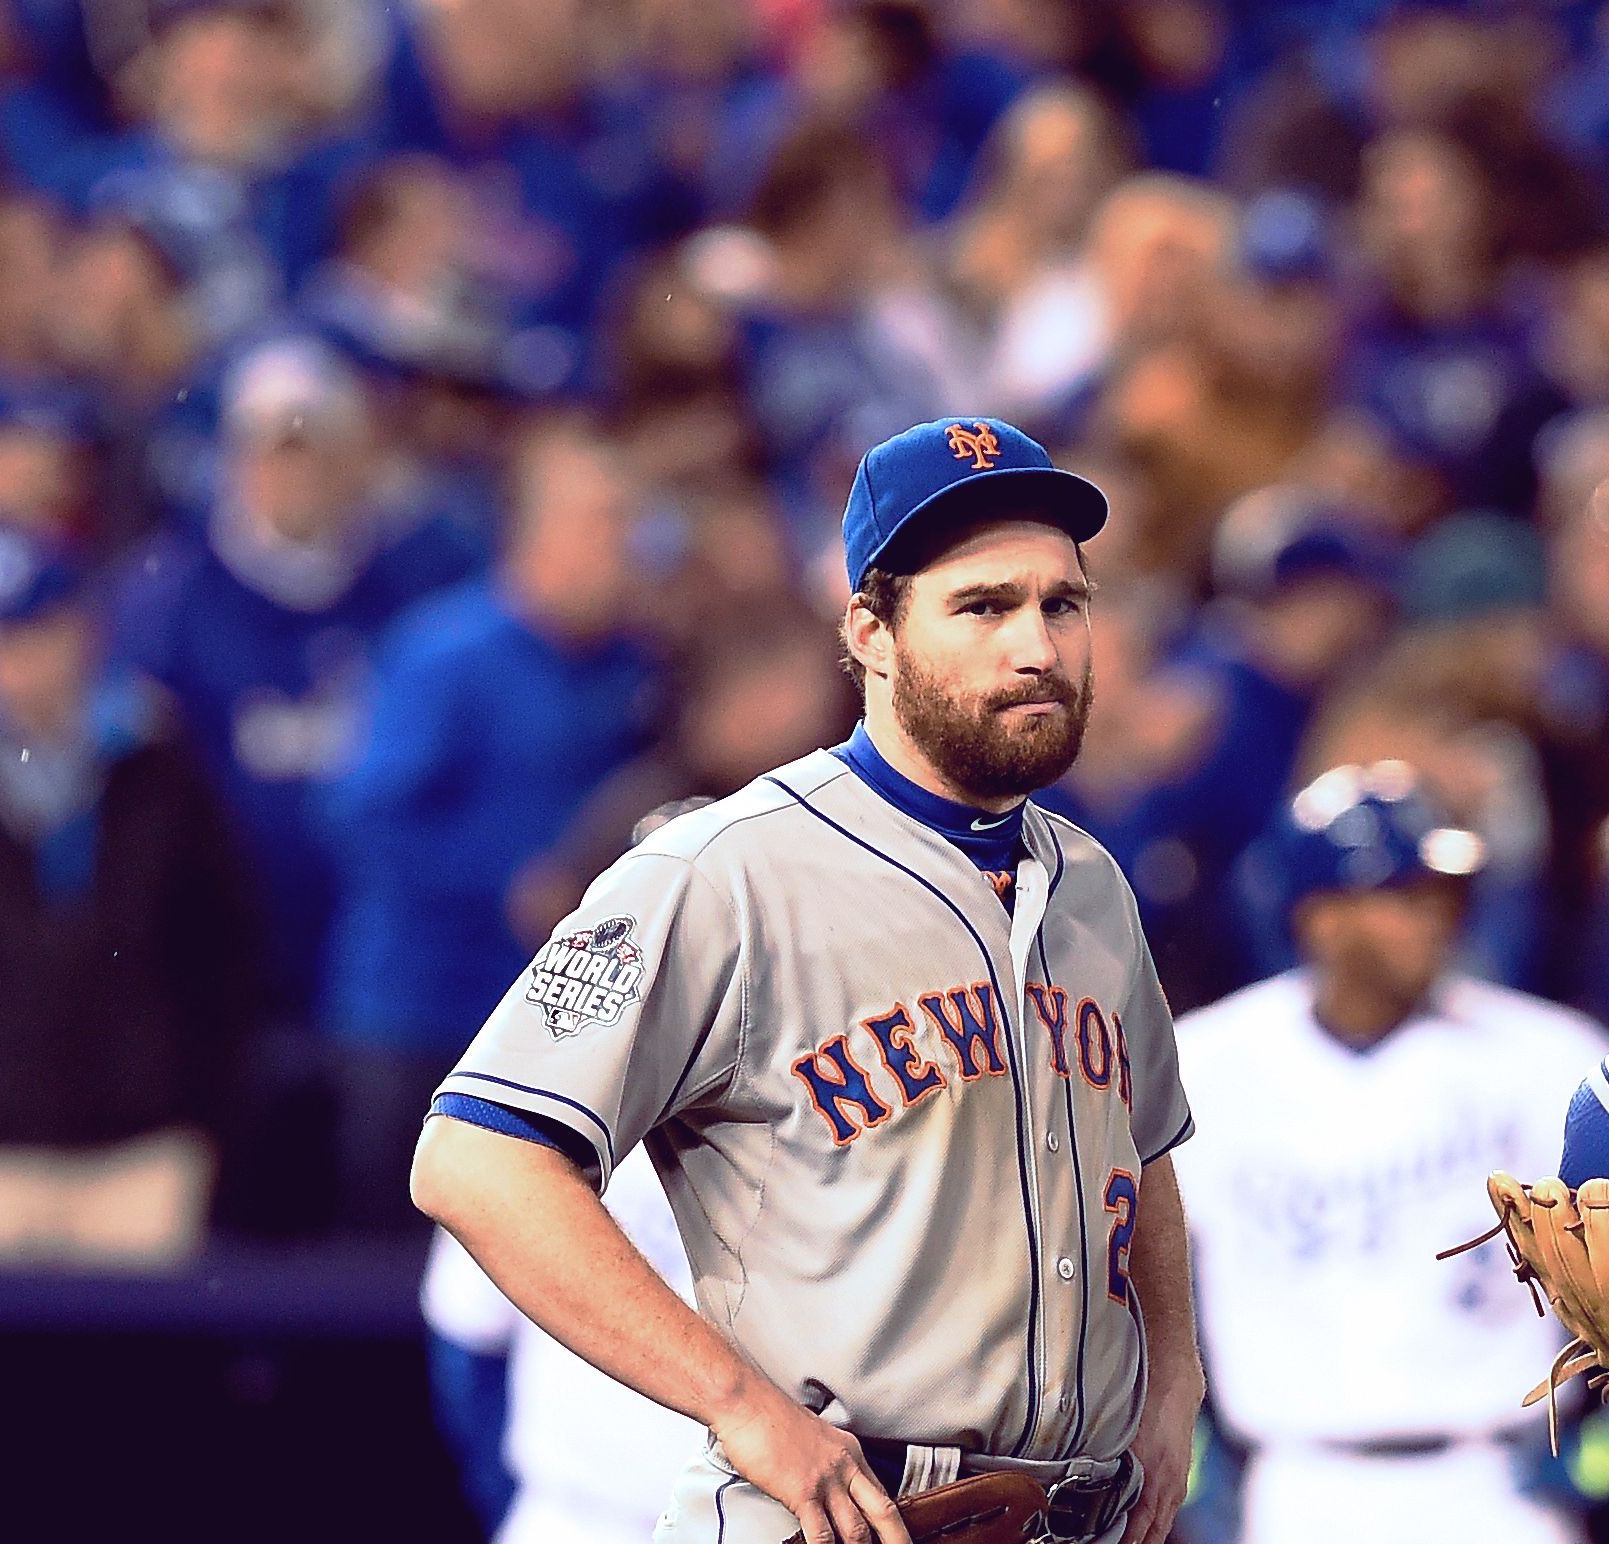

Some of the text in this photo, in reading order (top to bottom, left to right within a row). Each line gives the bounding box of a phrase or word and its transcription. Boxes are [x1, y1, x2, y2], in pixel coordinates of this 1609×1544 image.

[525, 970, 625, 1022] SERIES
[543, 942, 642, 995] WORLD
[791, 979, 1133, 1147] NEW YO
[1103, 1167, 1139, 1306] 2
